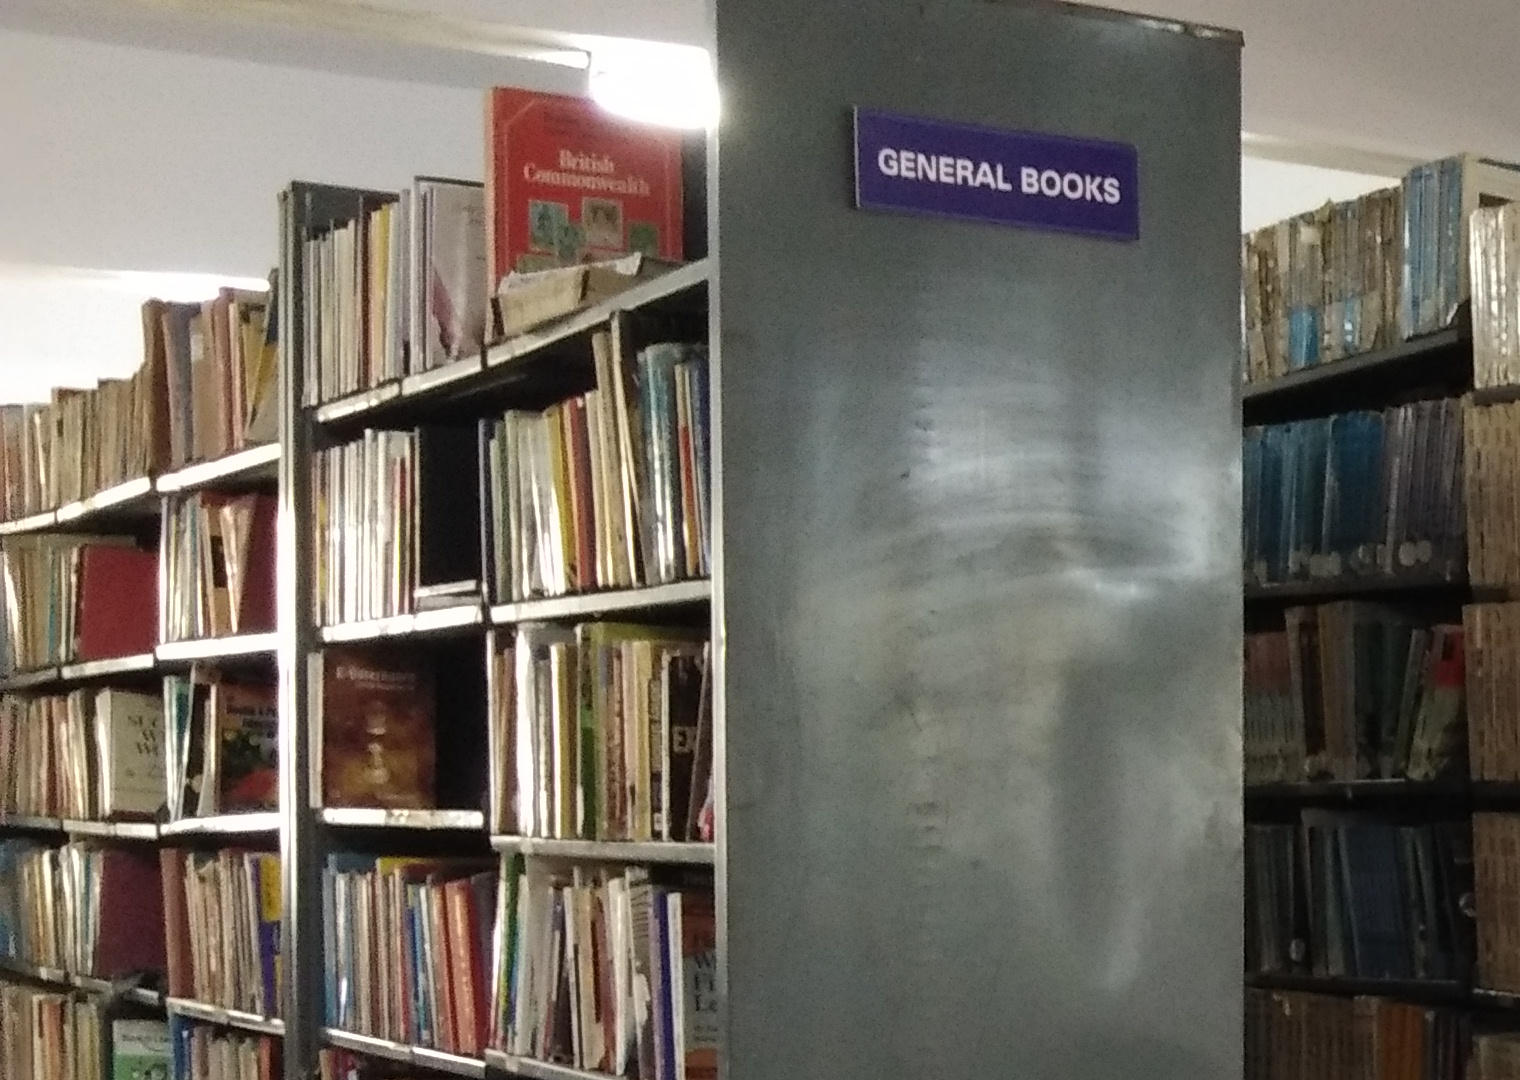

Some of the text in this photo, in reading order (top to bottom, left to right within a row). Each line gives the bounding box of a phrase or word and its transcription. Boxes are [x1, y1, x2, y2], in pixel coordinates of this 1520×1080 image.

[558, 149, 615, 174] British
[877, 147, 1121, 205] GENERAL BOOKS
[522, 162, 651, 196] Commonwealth
